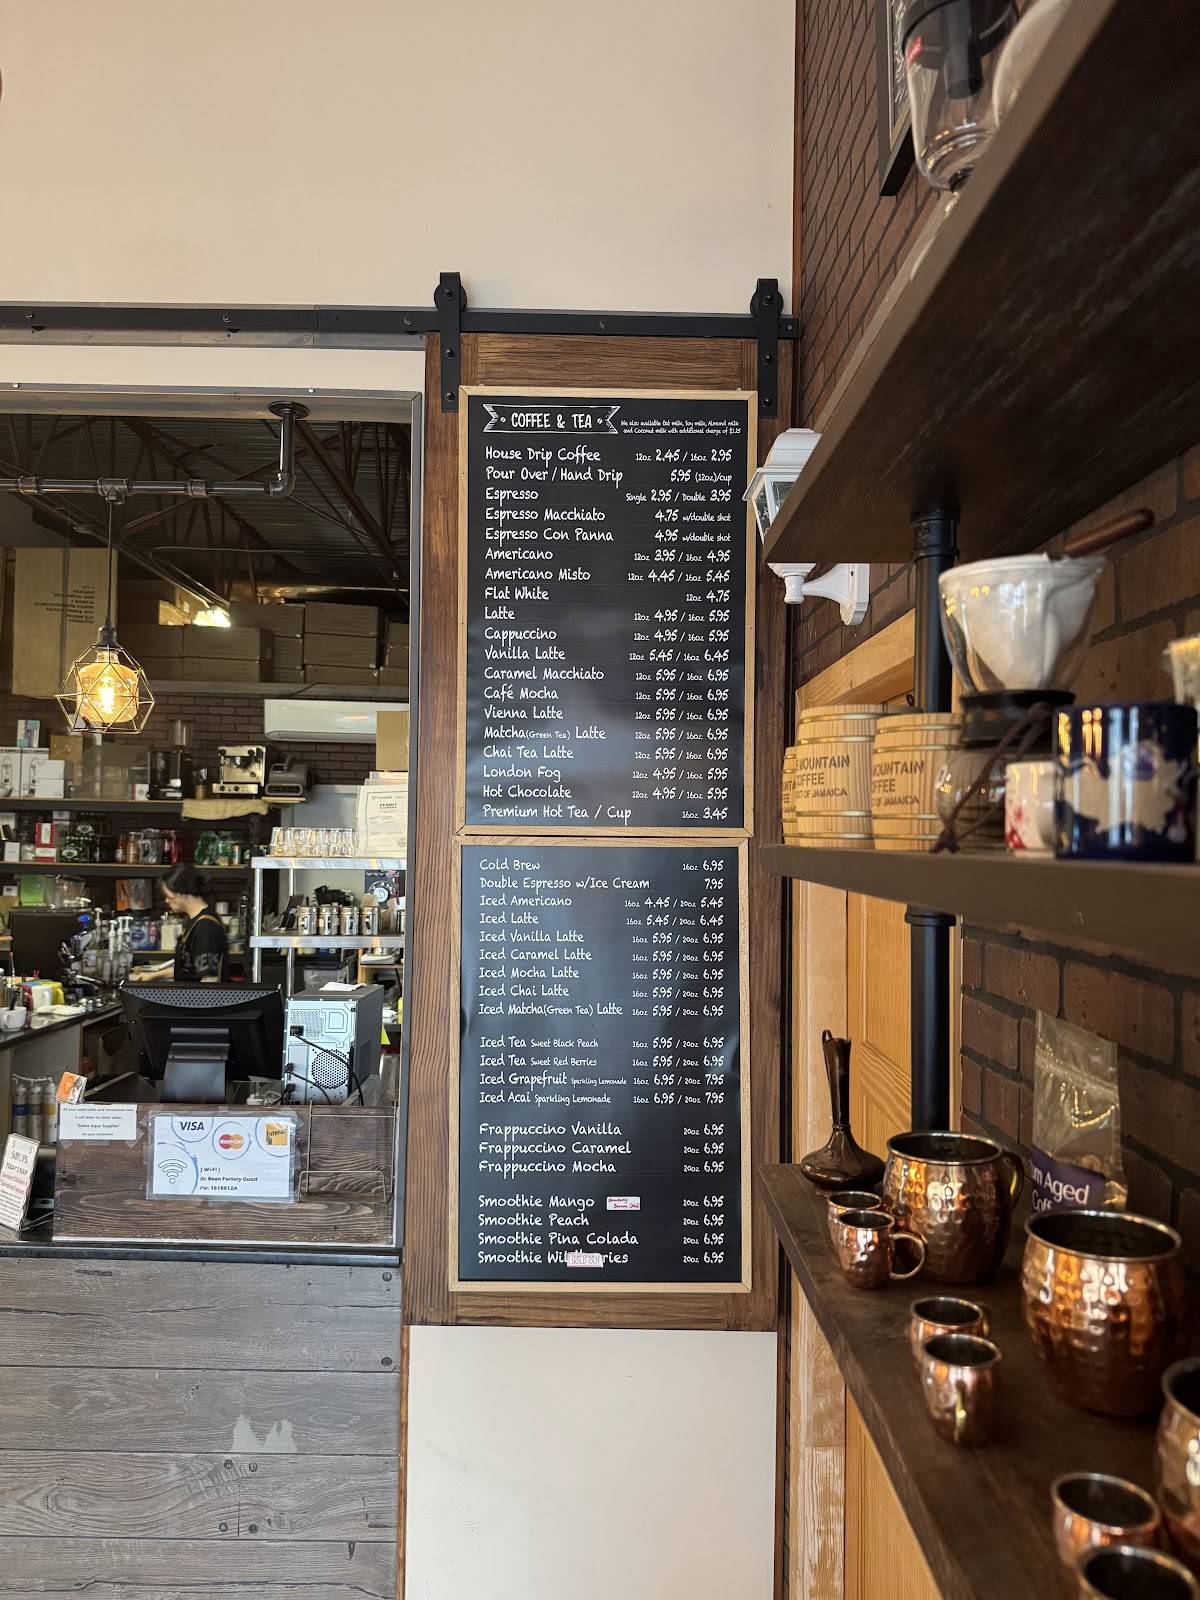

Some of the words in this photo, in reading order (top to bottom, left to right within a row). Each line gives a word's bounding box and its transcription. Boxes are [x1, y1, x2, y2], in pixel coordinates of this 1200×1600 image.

[511, 412, 551, 428] COFFEE
[556, 414, 566, 429] &
[571, 413, 592, 429] TEA
[486, 446, 522, 460] House
[527, 448, 552, 468] Drip
[557, 444, 601, 465] Coffee
[635, 453, 652, 461] 12oz
[656, 449, 680, 462] 2.45
[690, 453, 707, 461] 16oz
[711, 449, 732, 462] 2.95
[486, 466, 515, 480] Pour
[521, 467, 548, 480] Over
[551, 466, 557, 481] /
[561, 466, 593, 481] Hand
[597, 469, 623, 489] Drip
[486, 487, 539, 507] Espresso
[486, 507, 539, 527] Espresso
[544, 507, 605, 521] Macchiato
[485, 527, 538, 547] Espresso
[543, 528, 570, 540] Con
[575, 528, 614, 541] Panna
[485, 547, 553, 560] Americano
[485, 567, 553, 580] Americano
[558, 567, 591, 581] Misto
[485, 586, 510, 599] Flat
[515, 586, 549, 600] White
[485, 606, 515, 619] Latte
[484, 627, 557, 647] Cappuccino
[484, 644, 530, 660] Vanilla
[535, 646, 566, 660] Latte
[484, 666, 537, 679] Caramel
[543, 666, 604, 680] Macchiato
[484, 683, 514, 703] Café
[519, 686, 559, 700] Mocha
[484, 704, 528, 719] Vienna
[533, 705, 563, 719] Latte
[576, 725, 606, 739] Latte
[483, 745, 512, 758] Chai
[516, 745, 538, 758] Tea
[544, 745, 574, 758] Latte
[484, 764, 532, 778] London
[537, 766, 561, 783] Fog
[483, 784, 503, 797] Hot
[508, 784, 572, 798] Chocolate
[483, 804, 537, 818] Premium
[543, 804, 563, 817] Hot
[567, 805, 589, 818] Tea
[594, 804, 602, 819] /
[607, 806, 631, 826] Cup
[480, 858, 509, 870] Cold
[513, 860, 540, 870] Brew
[703, 860, 724, 871] 6.95
[480, 874, 518, 888] Double
[523, 877, 571, 895] Espresso
[576, 876, 608, 889] w/Ice
[613, 877, 649, 888] Cream
[480, 893, 507, 906] Iced
[510, 895, 572, 906] Americano
[480, 911, 507, 924] Iced
[511, 912, 539, 924] Latte
[480, 929, 507, 942] Iced
[510, 929, 551, 942] Vanilla
[557, 930, 584, 942] Latte
[479, 947, 506, 960] Iced
[510, 948, 559, 960] Caramel
[564, 948, 592, 960] Latte
[479, 965, 506, 978] Iced
[511, 966, 547, 979] Mocha
[552, 966, 579, 978] Latte
[479, 983, 506, 996] Iced
[510, 984, 537, 996] Chai
[542, 984, 569, 996] Latte
[478, 1001, 504, 1015] Iced
[597, 1002, 623, 1015] Latte
[480, 1034, 506, 1048] Iced
[508, 1036, 527, 1048] Tea
[530, 1038, 551, 1047] Sweet
[553, 1039, 574, 1047] Black
[577, 1038, 598, 1047] Peach
[480, 1053, 505, 1066] Iced
[508, 1054, 527, 1066] Tea
[530, 1057, 551, 1066] Sweet
[553, 1056, 569, 1066] Red
[571, 1058, 597, 1066] Berries
[480, 1071, 505, 1084] Iced
[508, 1070, 567, 1091] Grapefruit
[479, 1089, 505, 1103] Iced
[507, 1091, 531, 1103] Acai
[534, 1094, 570, 1107] Sparkling
[572, 1093, 611, 1103] Lemonade
[180, 1121, 205, 1131] VISA
[479, 1123, 566, 1142] Frappuccino
[571, 1121, 622, 1135] Vanilla
[479, 1142, 566, 1161] Frappuccino
[572, 1141, 632, 1154] Caramel
[479, 1160, 566, 1179] Frappuccino
[572, 1160, 616, 1173] Mocha
[1043, 1171, 1090, 1205] Aged
[478, 1194, 543, 1207] Smoothie
[549, 1195, 595, 1212] Mango
[478, 1213, 543, 1226] Smoothie
[548, 1213, 589, 1226] Peach
[478, 1231, 542, 1245] Smoothie
[548, 1232, 580, 1245] Pina
[586, 1230, 639, 1245] Colada
[478, 1250, 542, 1264] Smoothie
[547, 1248, 628, 1264] Wilries
